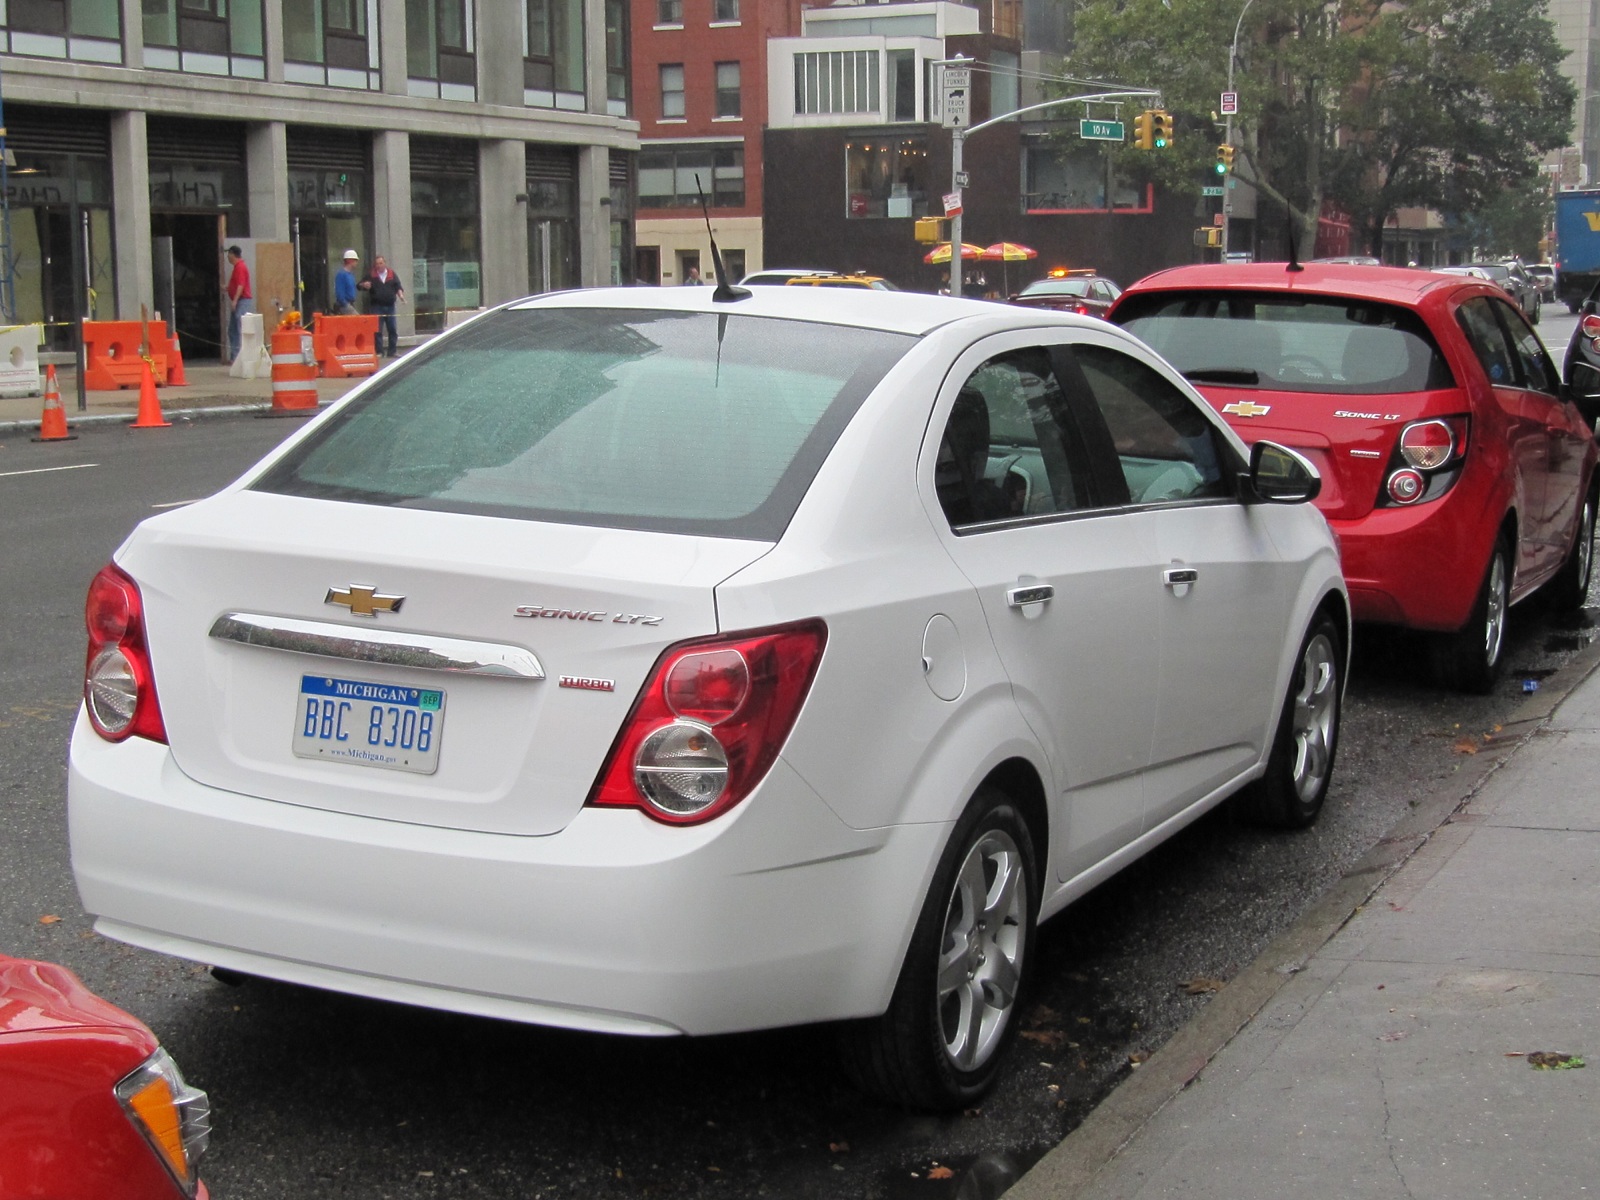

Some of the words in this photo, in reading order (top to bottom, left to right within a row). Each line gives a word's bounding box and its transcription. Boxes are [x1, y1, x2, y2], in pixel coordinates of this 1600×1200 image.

[1093, 126, 1101, 135] 10
[1101, 127, 1111, 136] Av
[1333, 410, 1381, 419] SONIC
[513, 605, 607, 622] SONIC
[612, 613, 664, 626] LTZ
[561, 676, 613, 690] TURBO
[336, 683, 408, 702] MICHIGAN
[423, 695, 438, 704] SEP
[304, 698, 352, 741] BBC
[368, 705, 433, 752] 8308
[331, 749, 397, 763] www.Michigan.gov
